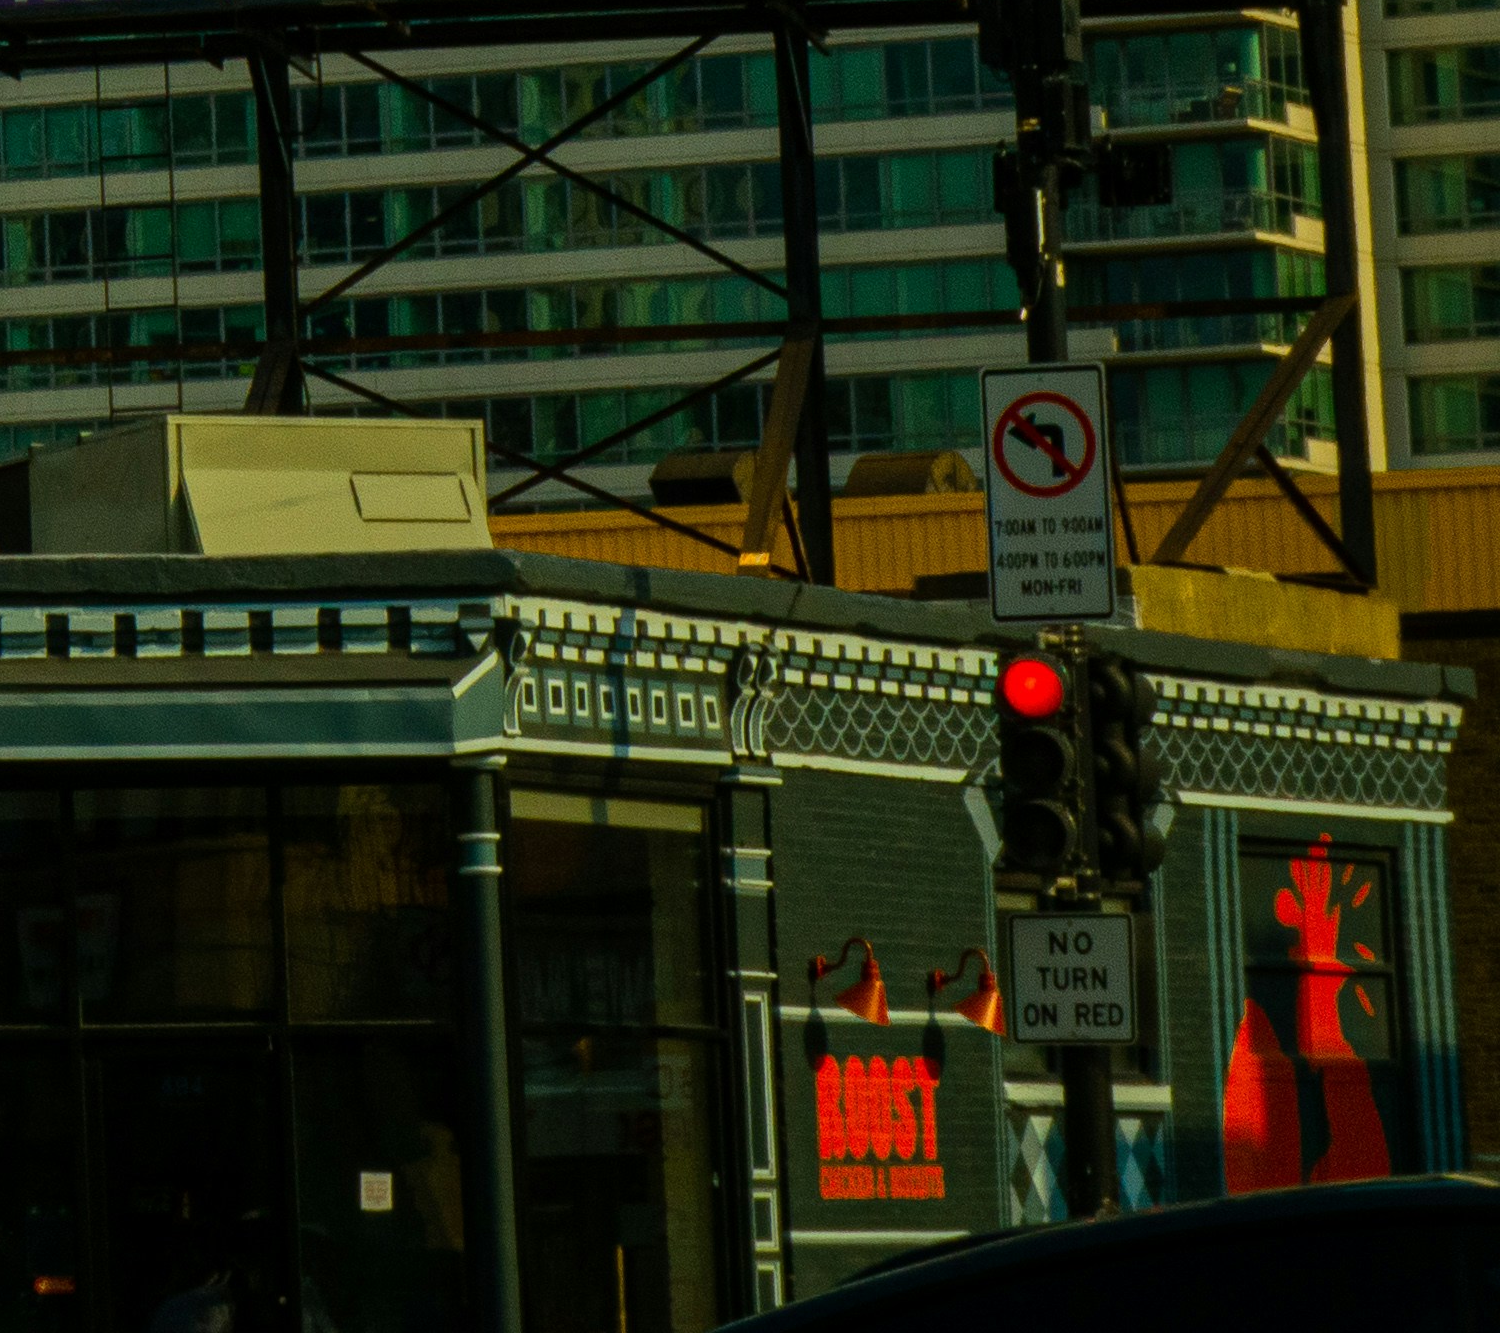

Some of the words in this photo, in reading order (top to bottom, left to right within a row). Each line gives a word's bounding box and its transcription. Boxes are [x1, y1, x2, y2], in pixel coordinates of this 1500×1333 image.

[1042, 517, 1056, 535] TO
[1044, 551, 1058, 570] TO
[1020, 577, 1083, 597] MON-FRI
[1048, 930, 1093, 956] NO
[1036, 966, 1108, 992] TURN
[1023, 1002, 1058, 1028] ON
[1076, 1002, 1124, 1028] RED
[815, 1054, 940, 1161] ROOST
